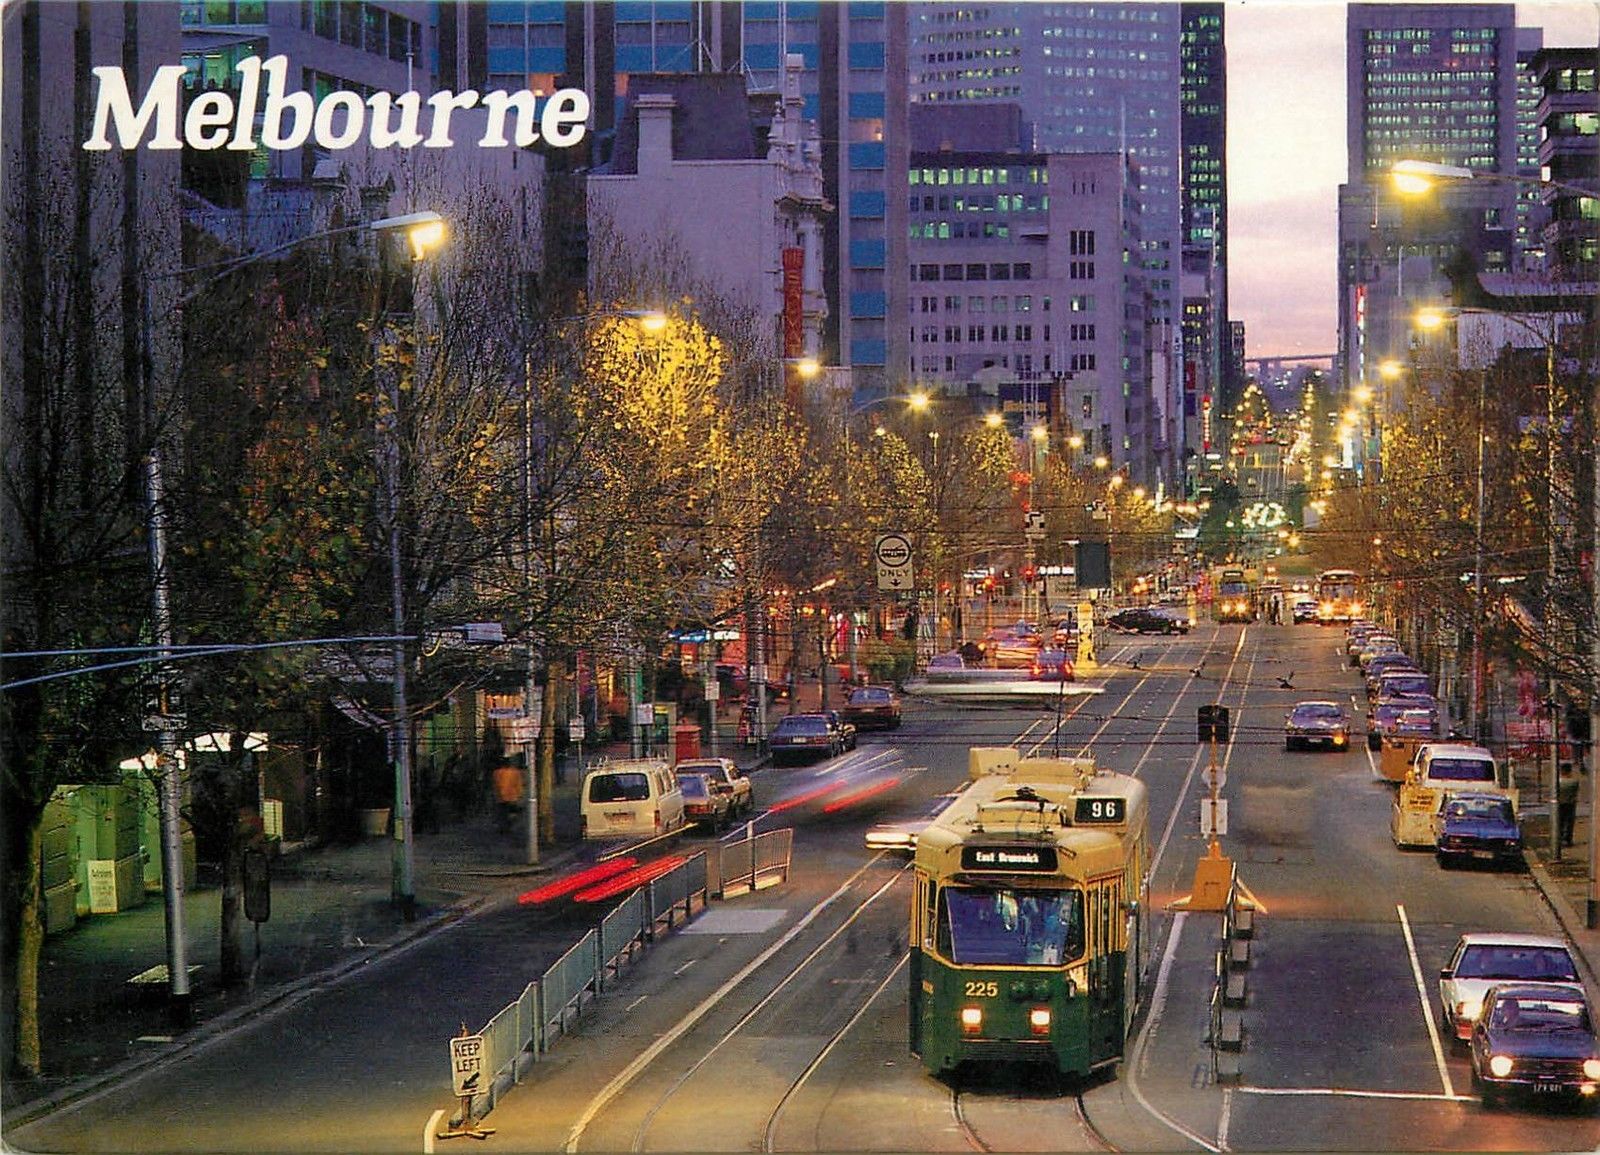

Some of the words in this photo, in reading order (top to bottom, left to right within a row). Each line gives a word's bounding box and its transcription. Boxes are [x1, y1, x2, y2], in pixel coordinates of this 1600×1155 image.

[880, 569, 908, 577] ONLY
[1091, 801, 1116, 818] 96
[965, 981, 998, 997] 225
[454, 1042, 480, 1057] KEEP
[456, 1057, 481, 1072] LEFT
